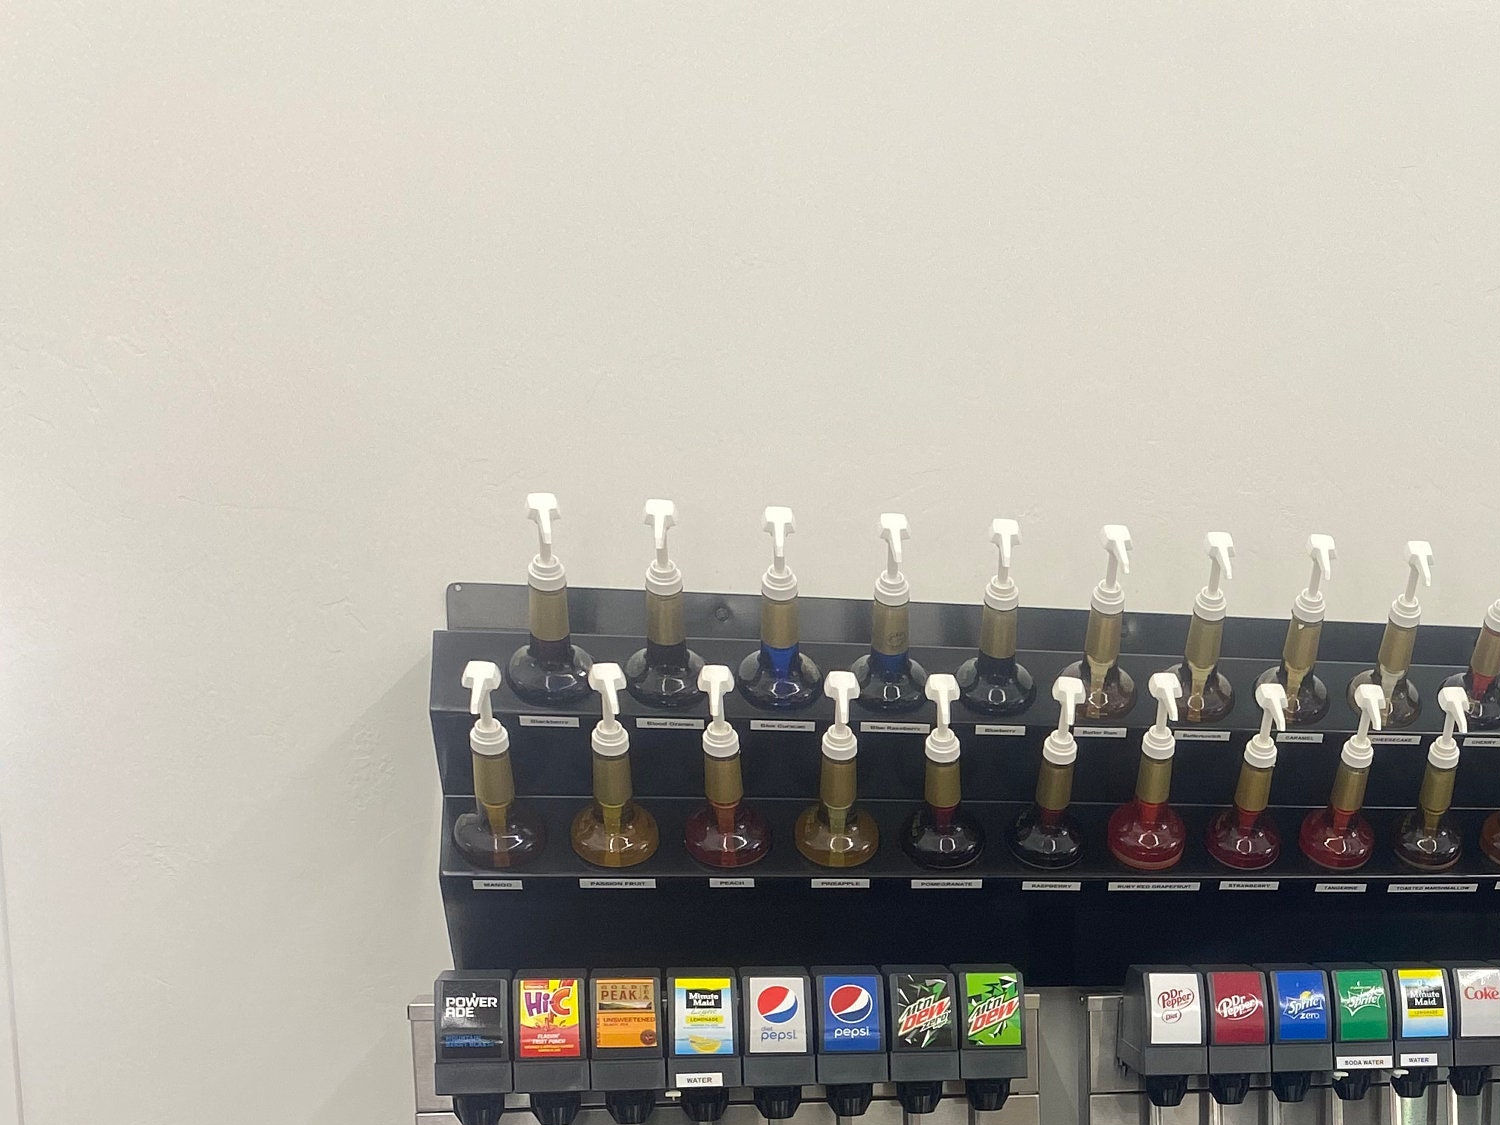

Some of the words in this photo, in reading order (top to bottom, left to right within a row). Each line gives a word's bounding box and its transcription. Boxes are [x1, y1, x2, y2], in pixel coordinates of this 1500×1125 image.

[601, 990, 638, 1000] PEAK
[688, 992, 720, 1000] Minute
[1170, 989, 1183, 999] Dr
[1410, 990, 1440, 998] Minute
[1464, 986, 1500, 1000] Coke
[445, 993, 498, 1008] POWER
[1160, 992, 1192, 1009] Pepper
[1231, 995, 1246, 1005] Dr
[1288, 998, 1319, 1014] Sprite
[1414, 998, 1437, 1006] Maid
[445, 1006, 475, 1018] ADE
[1220, 998, 1256, 1018] Pepper
[761, 1030, 796, 1042] pepsi
[834, 1026, 869, 1039] pepsi
